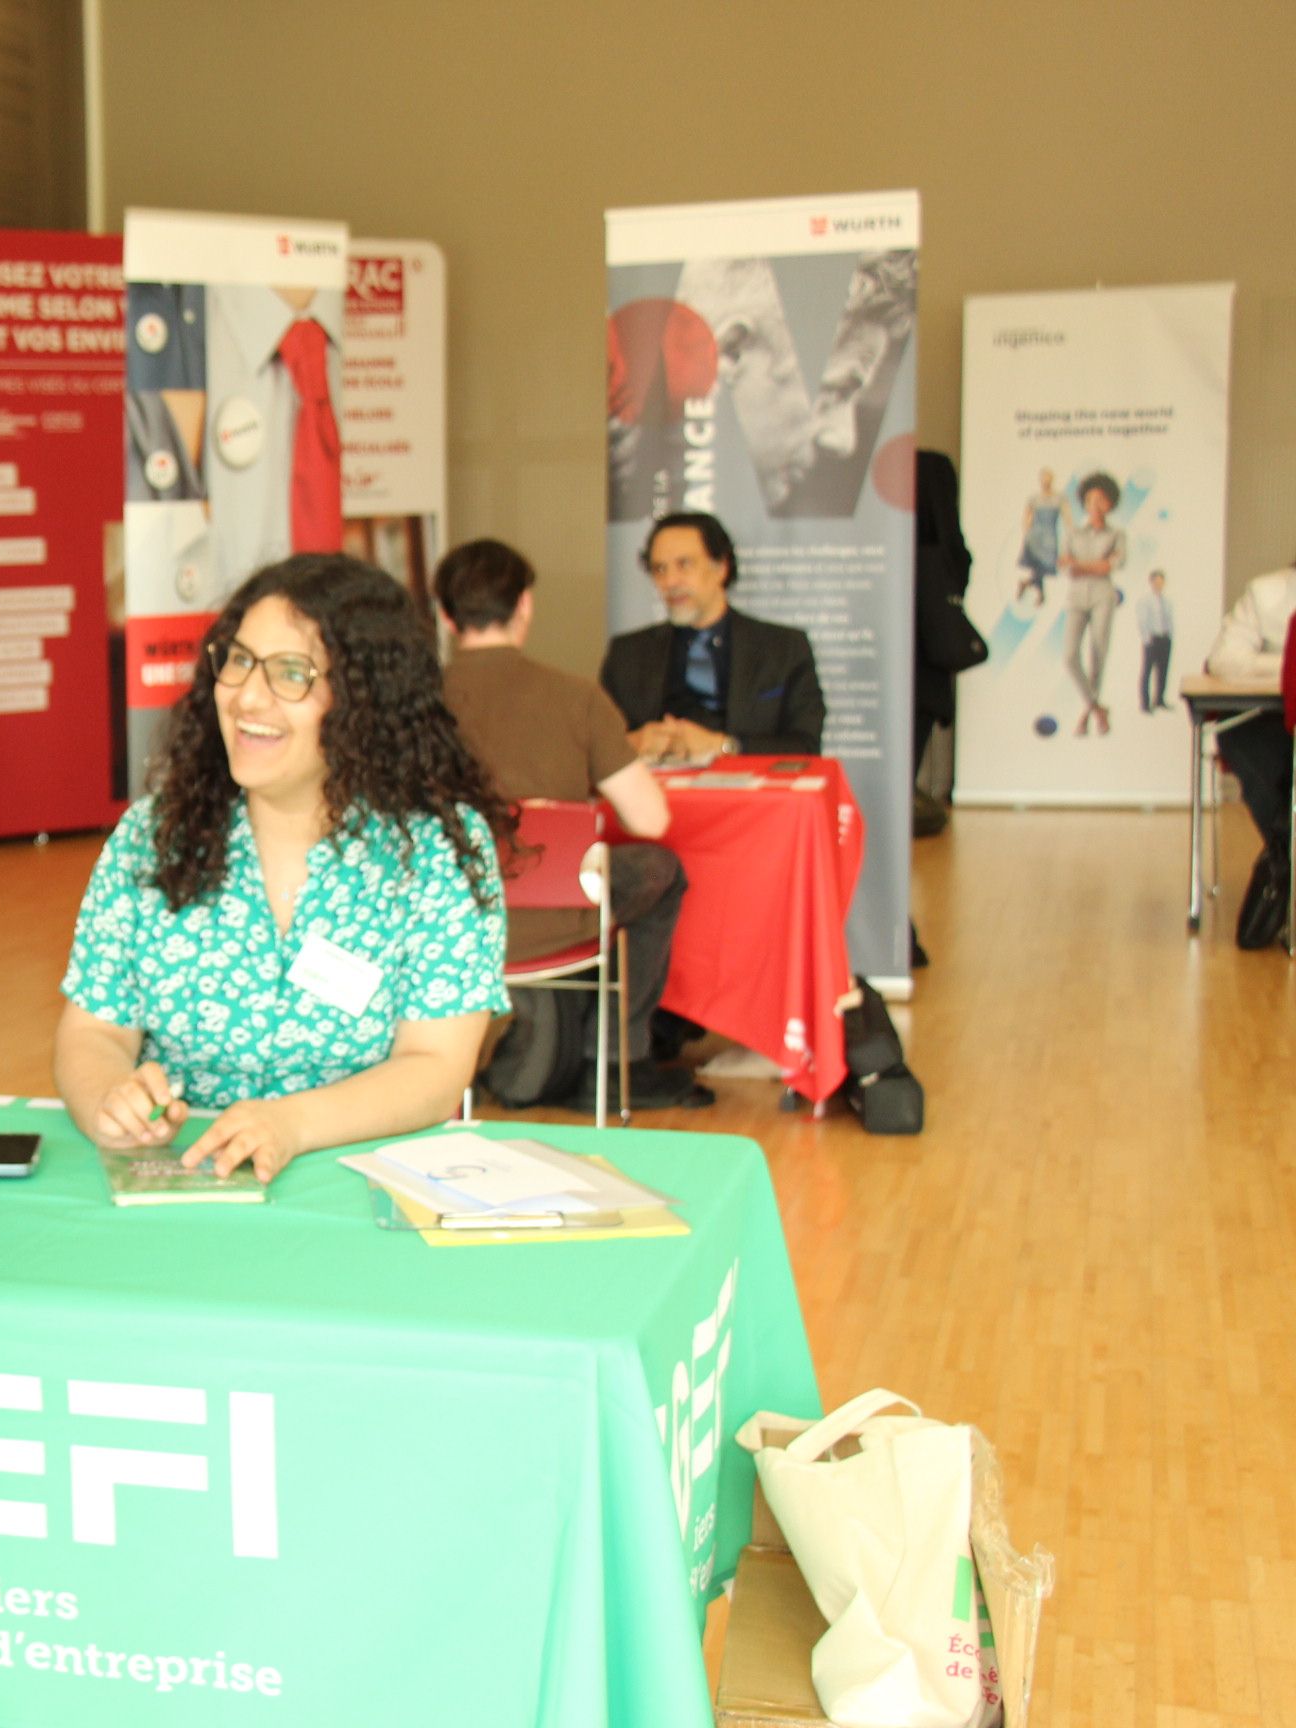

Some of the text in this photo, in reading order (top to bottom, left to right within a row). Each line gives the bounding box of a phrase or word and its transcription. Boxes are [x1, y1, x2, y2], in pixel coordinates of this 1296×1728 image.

[38, 294, 118, 321] SELON
[11, 325, 62, 352] VOS
[945, 1661, 973, 1679] de
